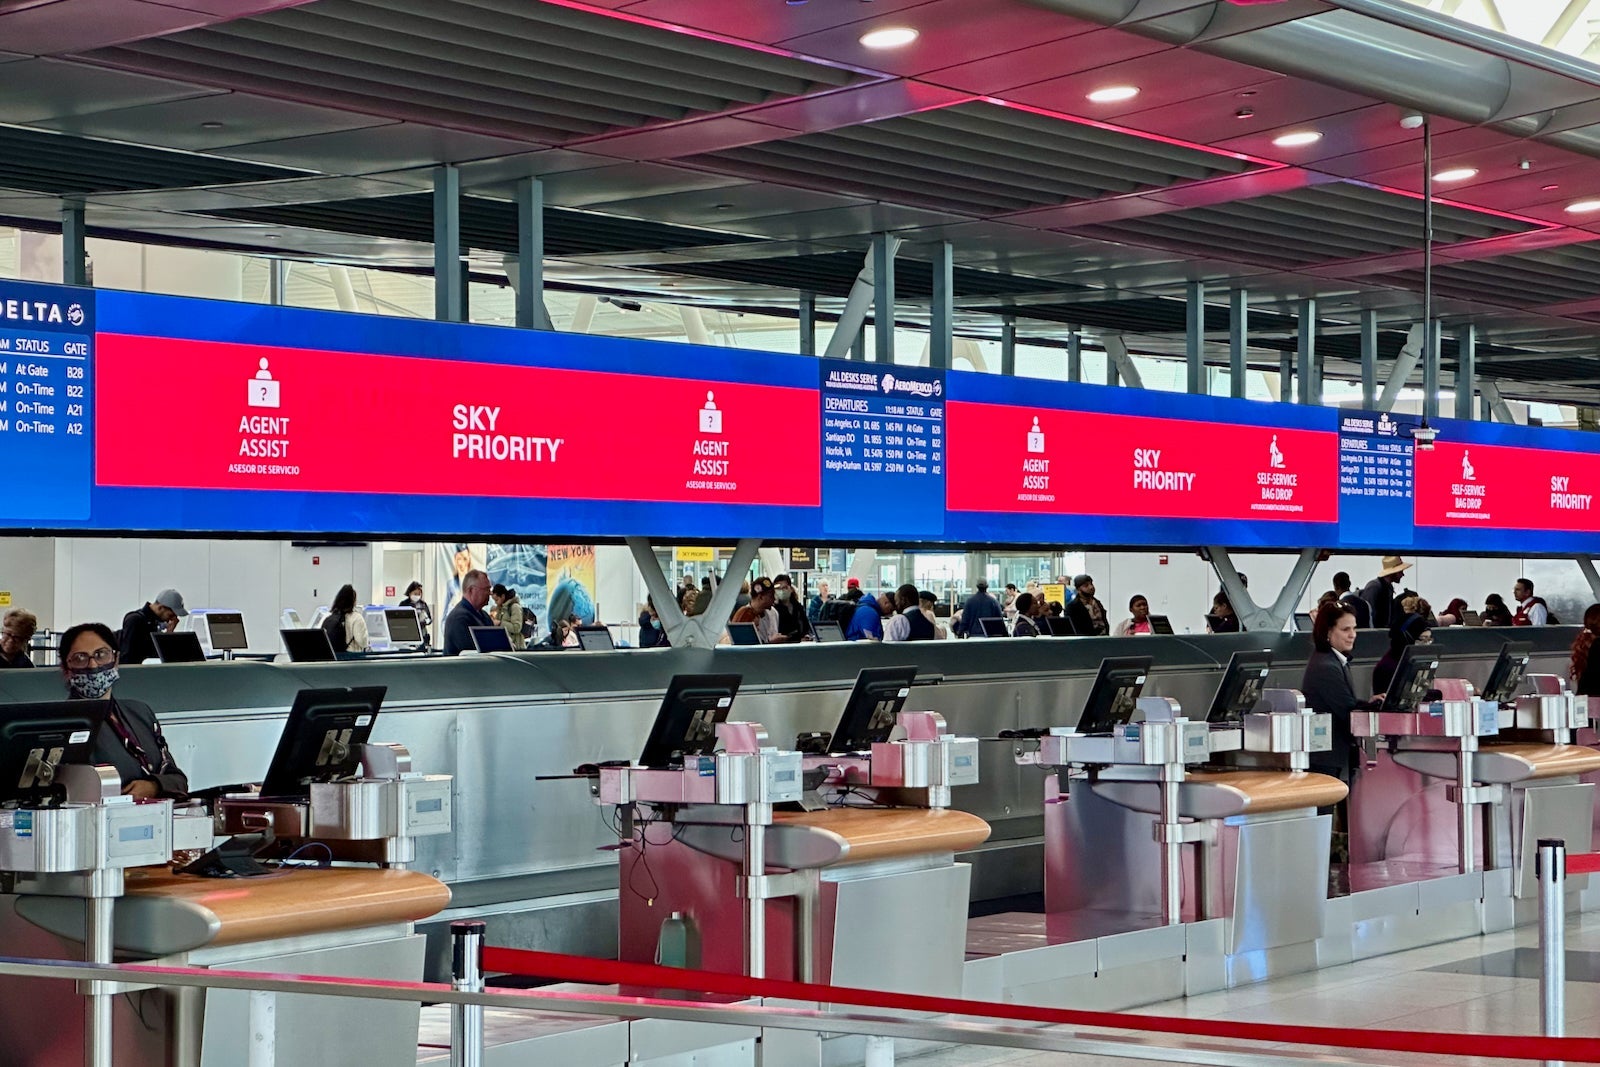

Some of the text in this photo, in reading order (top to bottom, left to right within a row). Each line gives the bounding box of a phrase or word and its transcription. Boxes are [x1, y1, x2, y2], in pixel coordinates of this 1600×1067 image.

[0, 300, 62, 323] ELTA
[16, 338, 49, 352] STATUS
[64, 342, 87, 356] GATE
[16, 363, 26, 375] At
[28, 364, 48, 376] Gate
[67, 367, 84, 379] B28
[830, 371, 878, 384] ALL DESKS SERVE
[16, 382, 54, 396] On-Time
[67, 386, 83, 398] B22
[16, 401, 54, 415] On-Time
[67, 404, 82, 416] A21
[826, 398, 868, 412] DEPARTURES
[906, 406, 924, 416] STATUS
[930, 408, 942, 417] GATE
[453, 404, 500, 431] SKY
[16, 420, 54, 434] On-Time
[67, 423, 83, 435] A12
[239, 416, 290, 435] AGENT
[825, 418, 833, 427] Los
[853, 420, 860, 428] CA
[864, 421, 870, 430] DL
[895, 423, 903, 431] PM
[912, 424, 923, 433] Gate
[825, 432, 846, 444] Santiago
[846, 433, 855, 442] DO
[864, 434, 870, 443] DL
[895, 436, 903, 445] PM
[906, 437, 926, 447] On-Time
[239, 439, 289, 458] ASSIST
[693, 440, 729, 456] AGENT
[845, 447, 852, 456] VA
[864, 448, 870, 457] DL
[895, 450, 903, 459] PM
[906, 450, 927, 460] On-Time
[1134, 448, 1161, 468] SKY
[228, 464, 300, 475] ASESOR DE SERVICIO
[693, 459, 729, 476] ASSIST
[864, 462, 870, 471] DL
[895, 463, 904, 472] PM
[906, 464, 927, 474] On-Time
[1023, 459, 1050, 473] AGENT
[686, 481, 737, 490] ASESOR DE SERVICIO
[1023, 475, 1050, 490] ASSIST
[1257, 472, 1297, 486] SELF-SERVICE
[1551, 476, 1569, 492] SKY
[1262, 487, 1293, 501] BAG DROP
[1452, 484, 1485, 496] SELF-SERVICE
[1455, 497, 1482, 509] BAG DROP
[550, 545, 594, 561] NEW YORK
